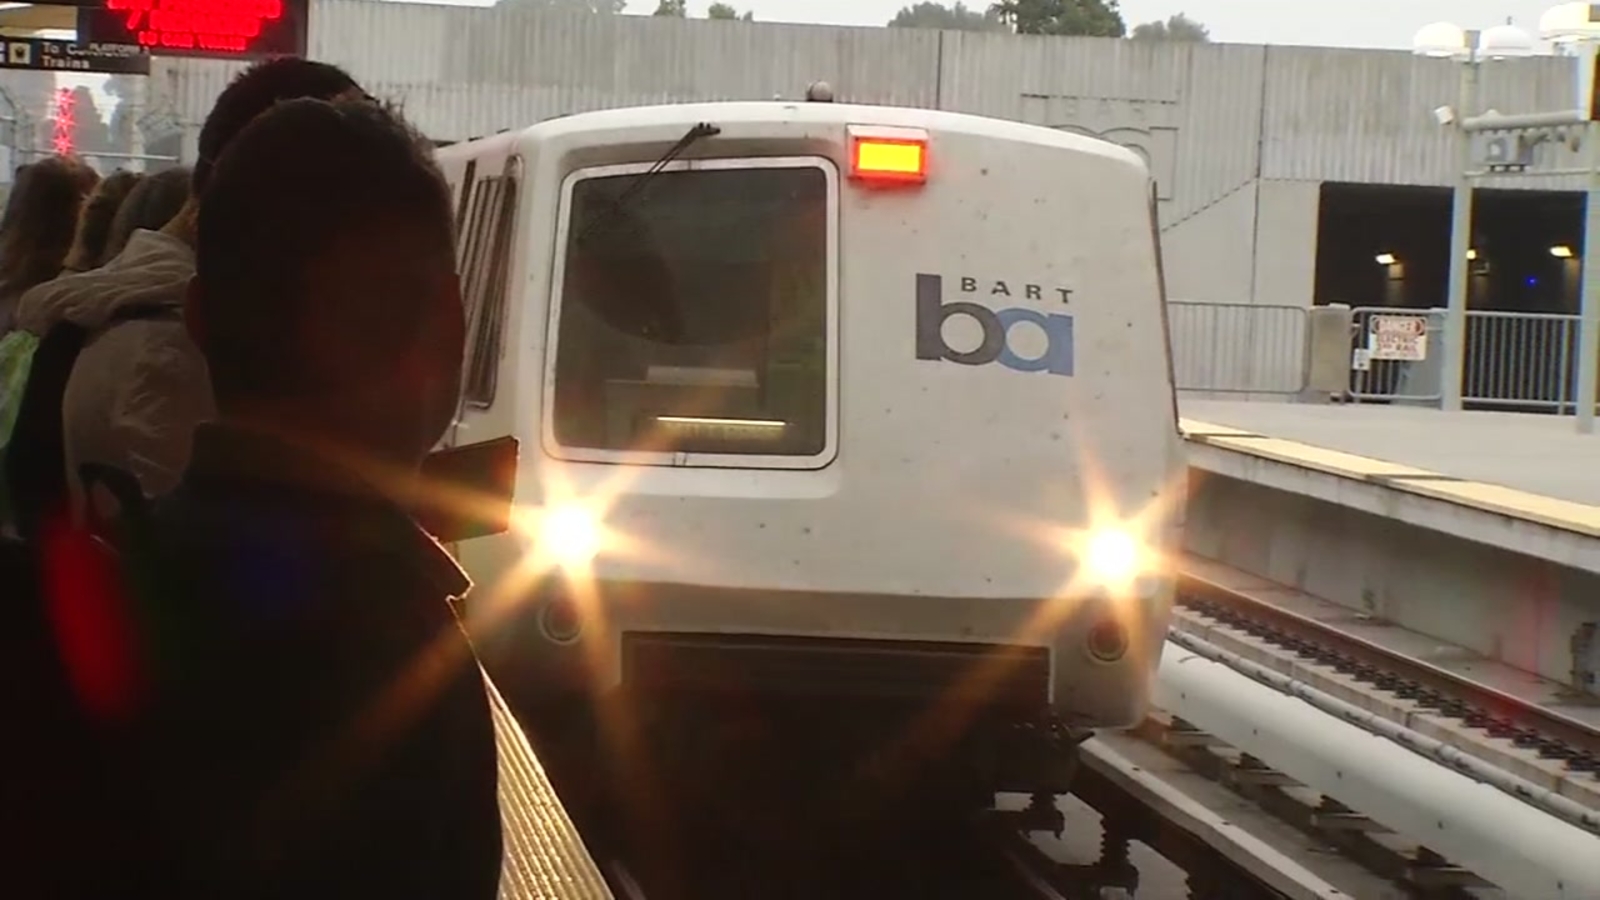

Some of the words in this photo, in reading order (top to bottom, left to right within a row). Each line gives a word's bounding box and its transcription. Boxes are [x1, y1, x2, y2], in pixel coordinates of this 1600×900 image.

[42, 42, 61, 54] To
[42, 55, 90, 69] Trains
[961, 277, 1073, 304] BART
